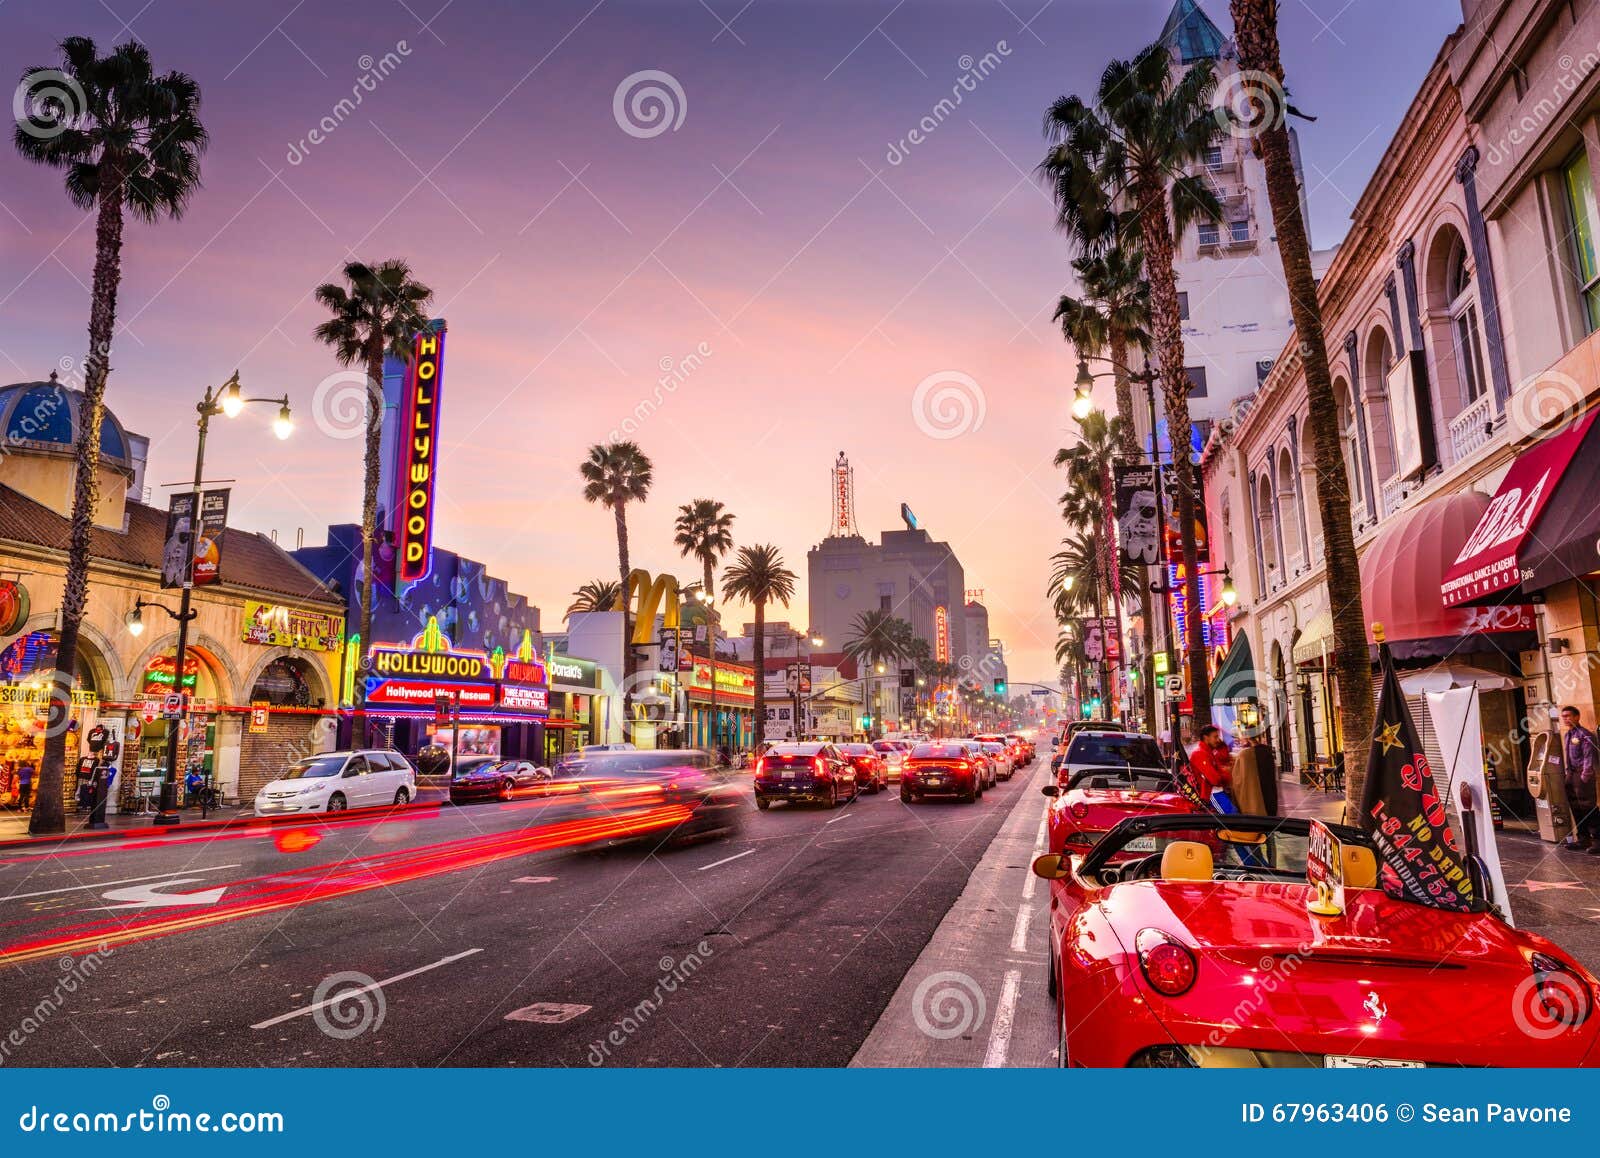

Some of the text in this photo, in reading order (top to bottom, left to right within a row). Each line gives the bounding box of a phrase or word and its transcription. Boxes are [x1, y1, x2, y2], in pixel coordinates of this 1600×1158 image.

[406, 336, 436, 562] HOLLYWOOD
[1441, 555, 1517, 594] INTERNATIONAL DANCE ACADEMY
[1521, 567, 1534, 581] Paris
[965, 589, 984, 597] ELT
[1443, 569, 1519, 605] HOLLYWOOD
[377, 652, 481, 677] HOLLYWOOD
[509, 663, 543, 682] HOLLYWOOD
[2, 688, 49, 703] SOUVENI
[386, 686, 433, 699] Hollywood
[435, 688, 455, 698] Wax
[1407, 814, 1432, 842] NO
